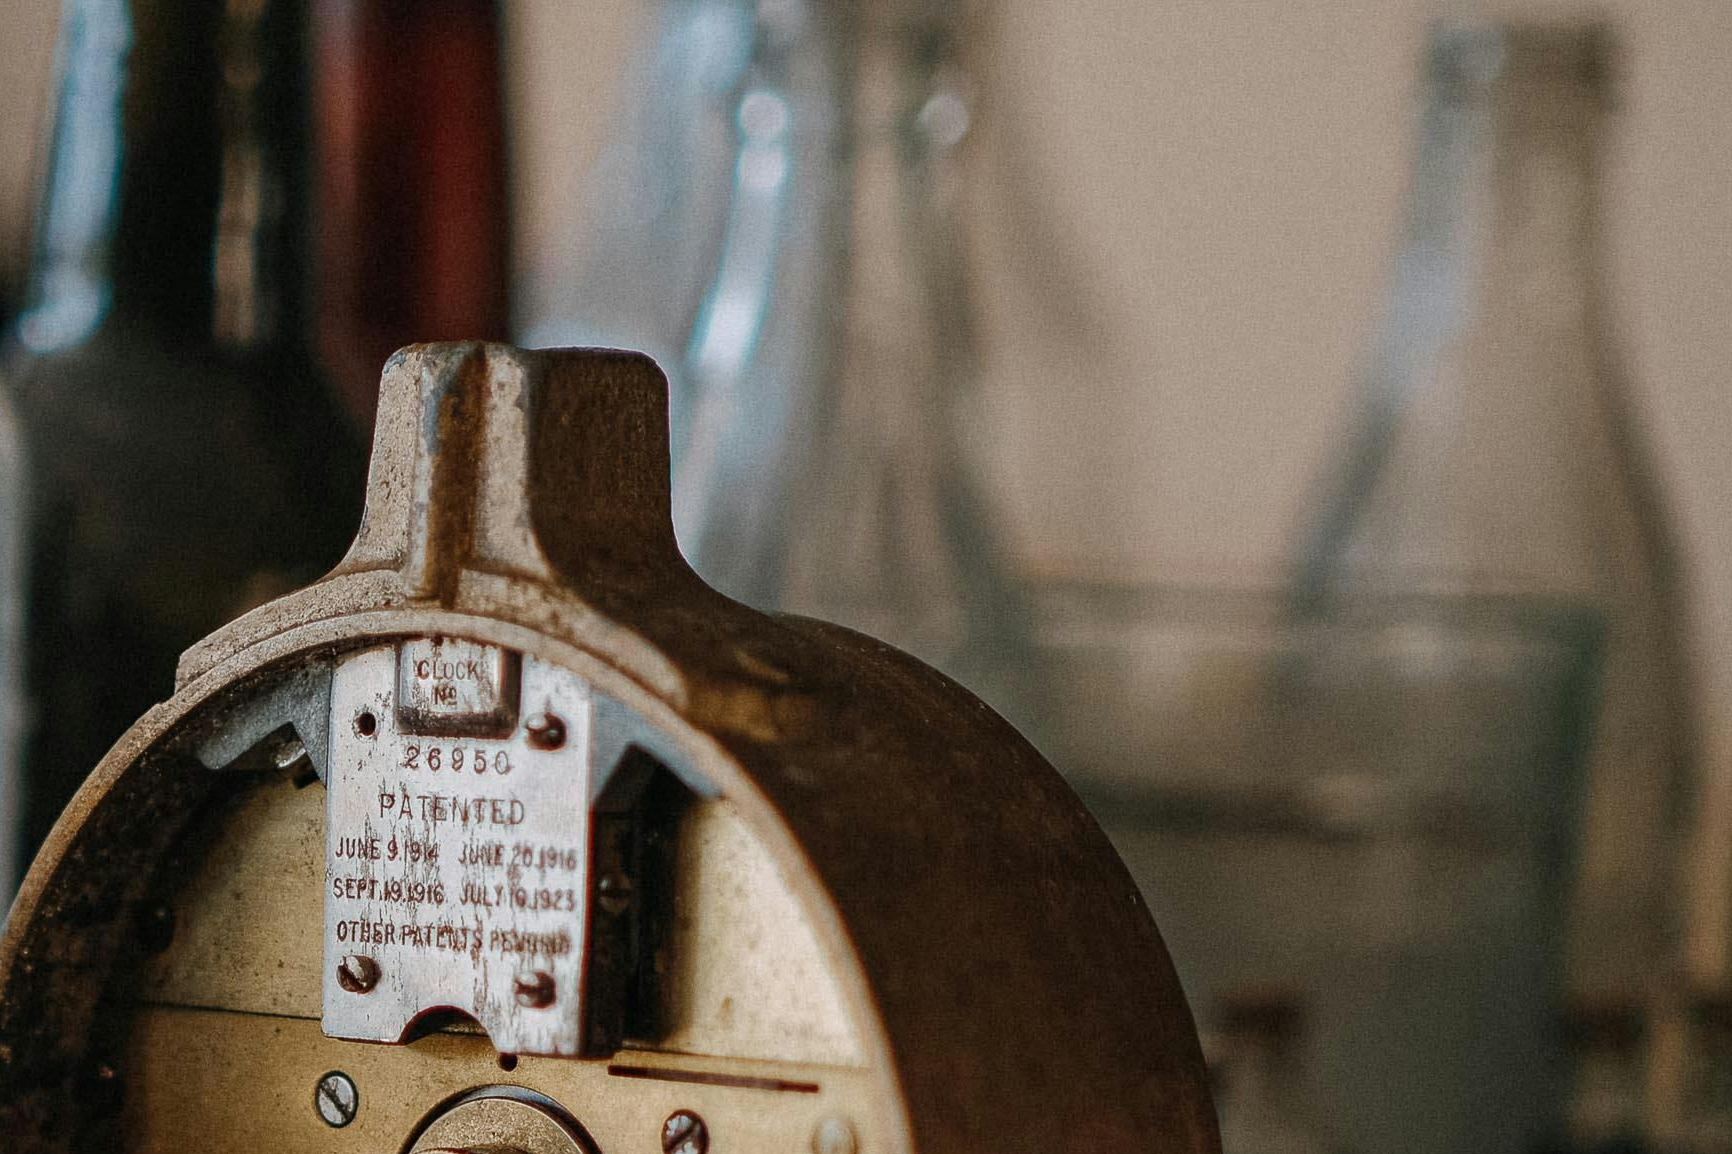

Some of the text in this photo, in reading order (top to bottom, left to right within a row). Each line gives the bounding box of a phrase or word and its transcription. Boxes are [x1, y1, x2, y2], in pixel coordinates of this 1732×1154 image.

[416, 658, 479, 681] CLOCK
[404, 745, 510, 775] 26950
[379, 793, 525, 825] PATENTED
[335, 838, 381, 861] JUNE
[458, 844, 505, 867] JUNE
[459, 883, 504, 908] JULY
[336, 920, 395, 945] OTHER
[401, 923, 484, 952] PATENTS
